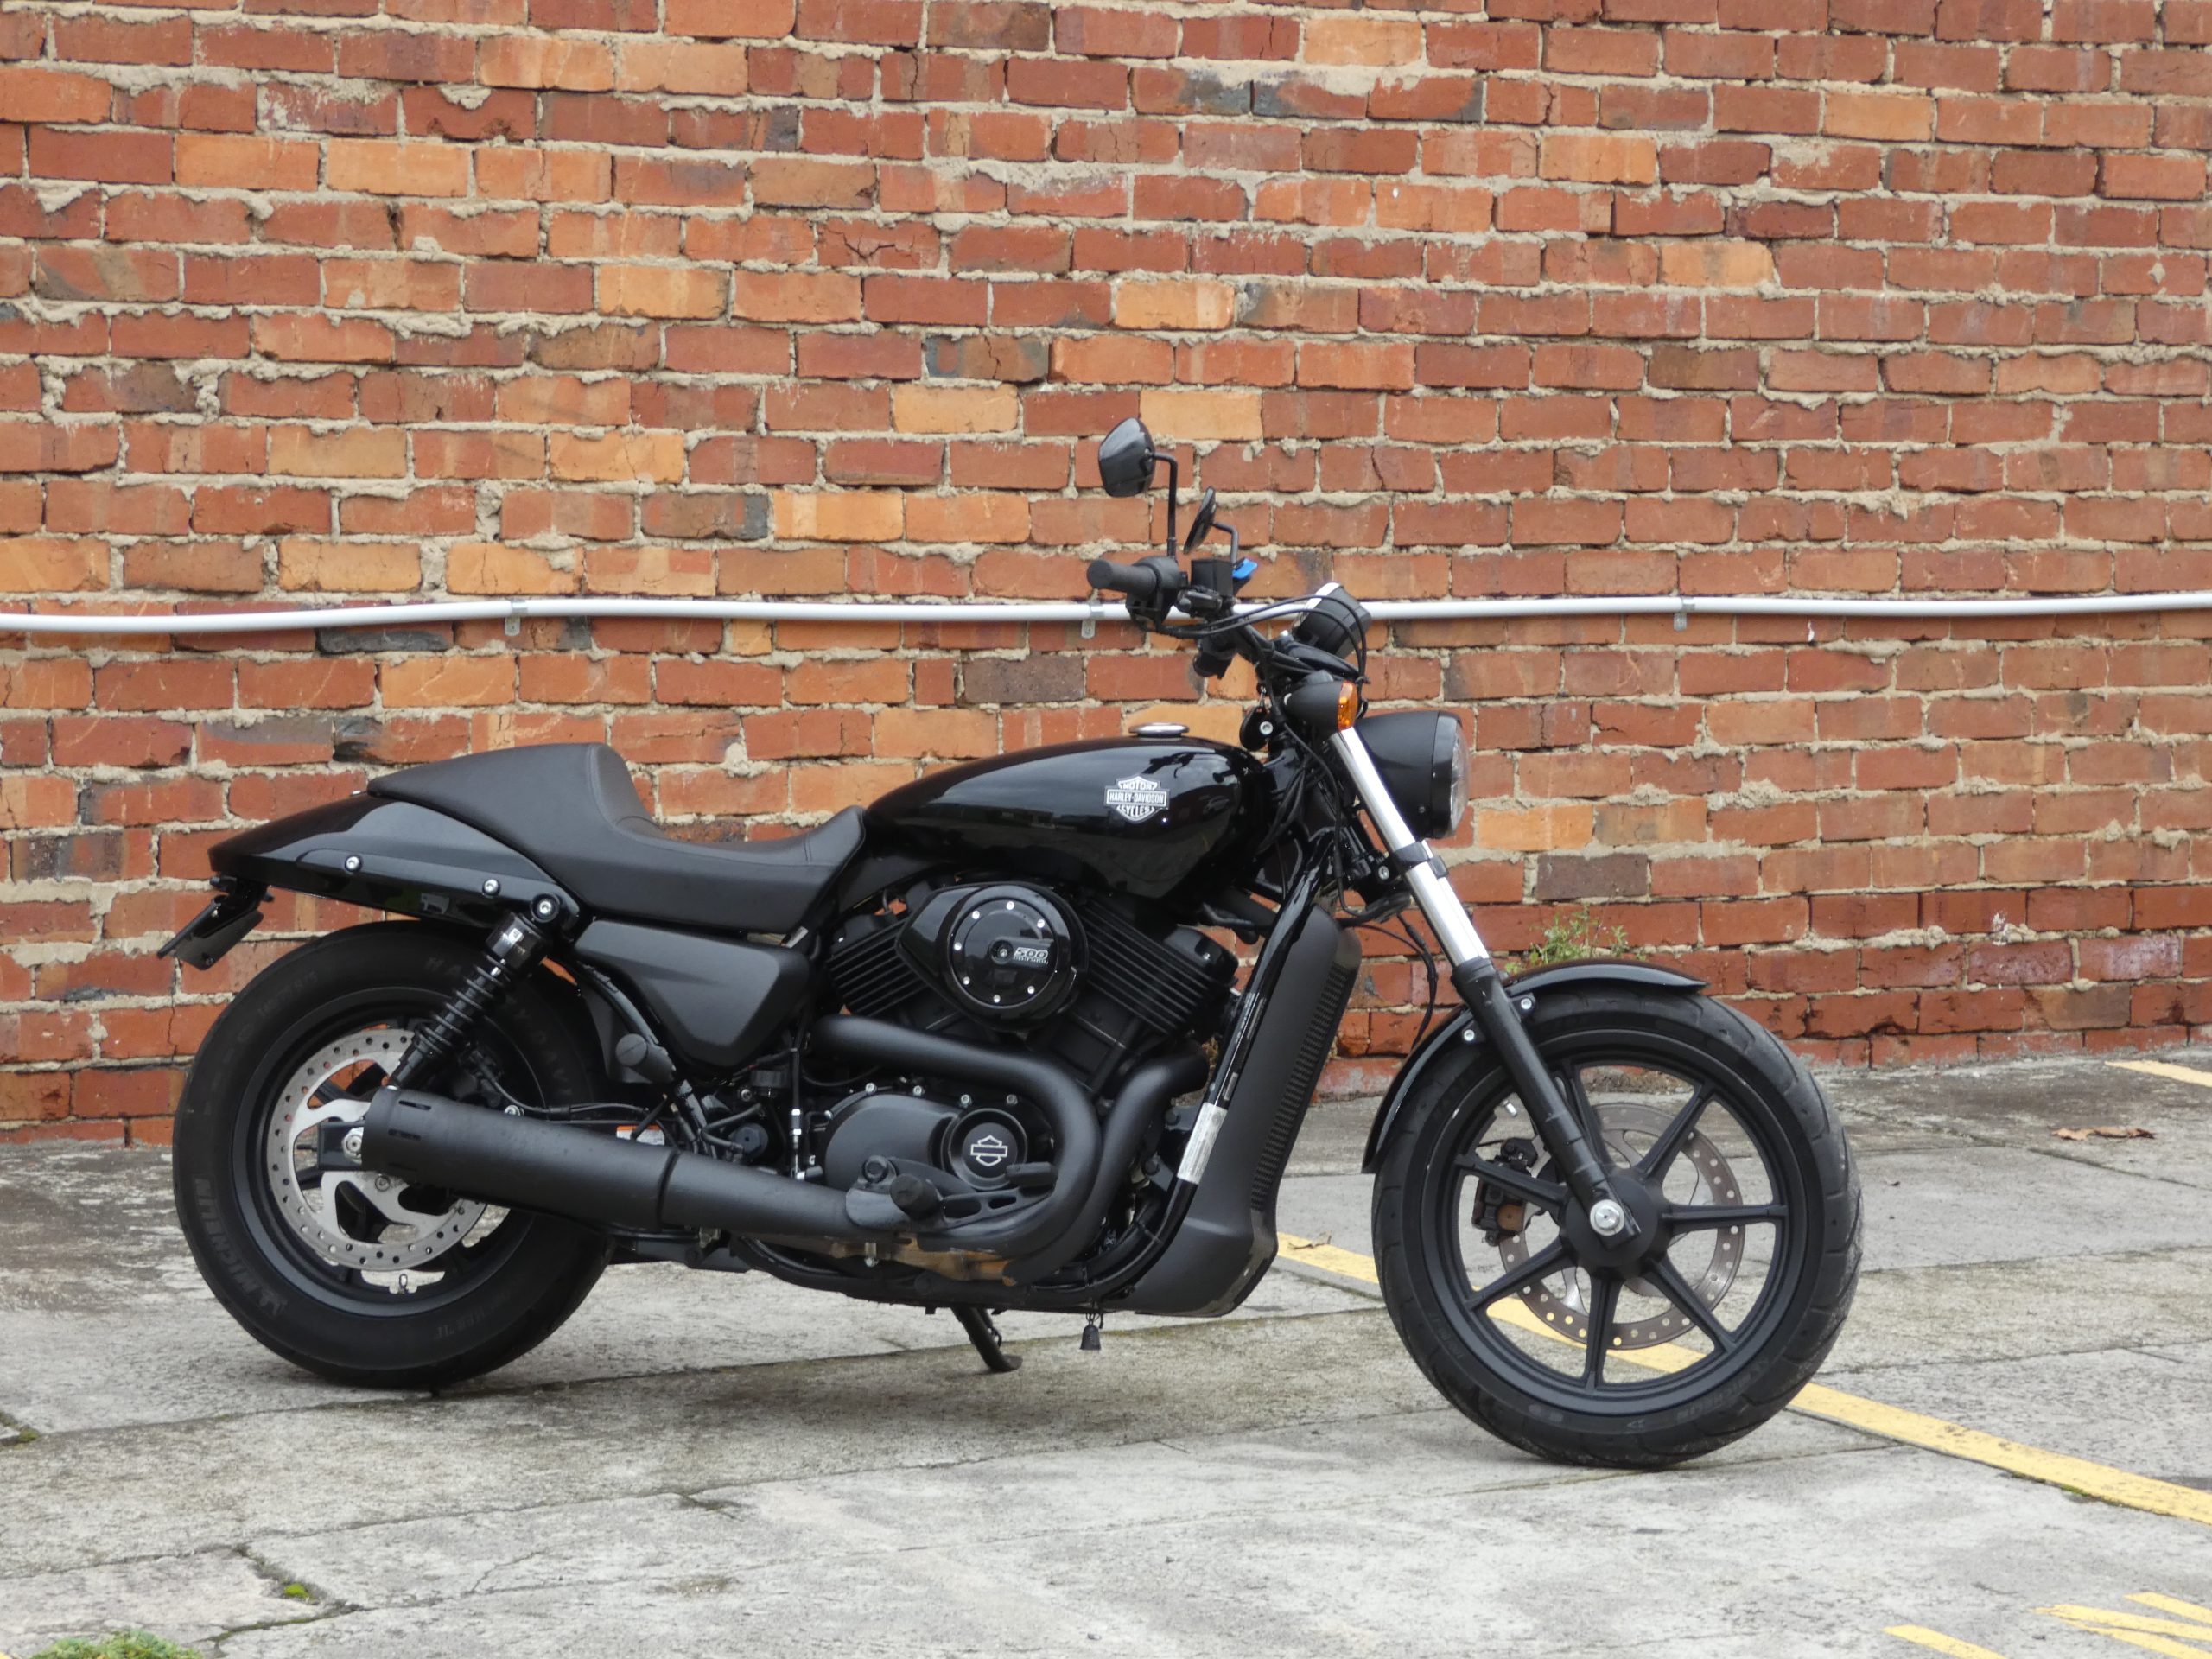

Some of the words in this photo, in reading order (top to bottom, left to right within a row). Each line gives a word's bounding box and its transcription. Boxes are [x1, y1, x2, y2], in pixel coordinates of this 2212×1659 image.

[1121, 781, 1154, 790] MOTOR
[1120, 805, 1152, 817] CYCLES
[1014, 947, 1049, 959] 500
[194, 1177, 259, 1295] MICHELIN
